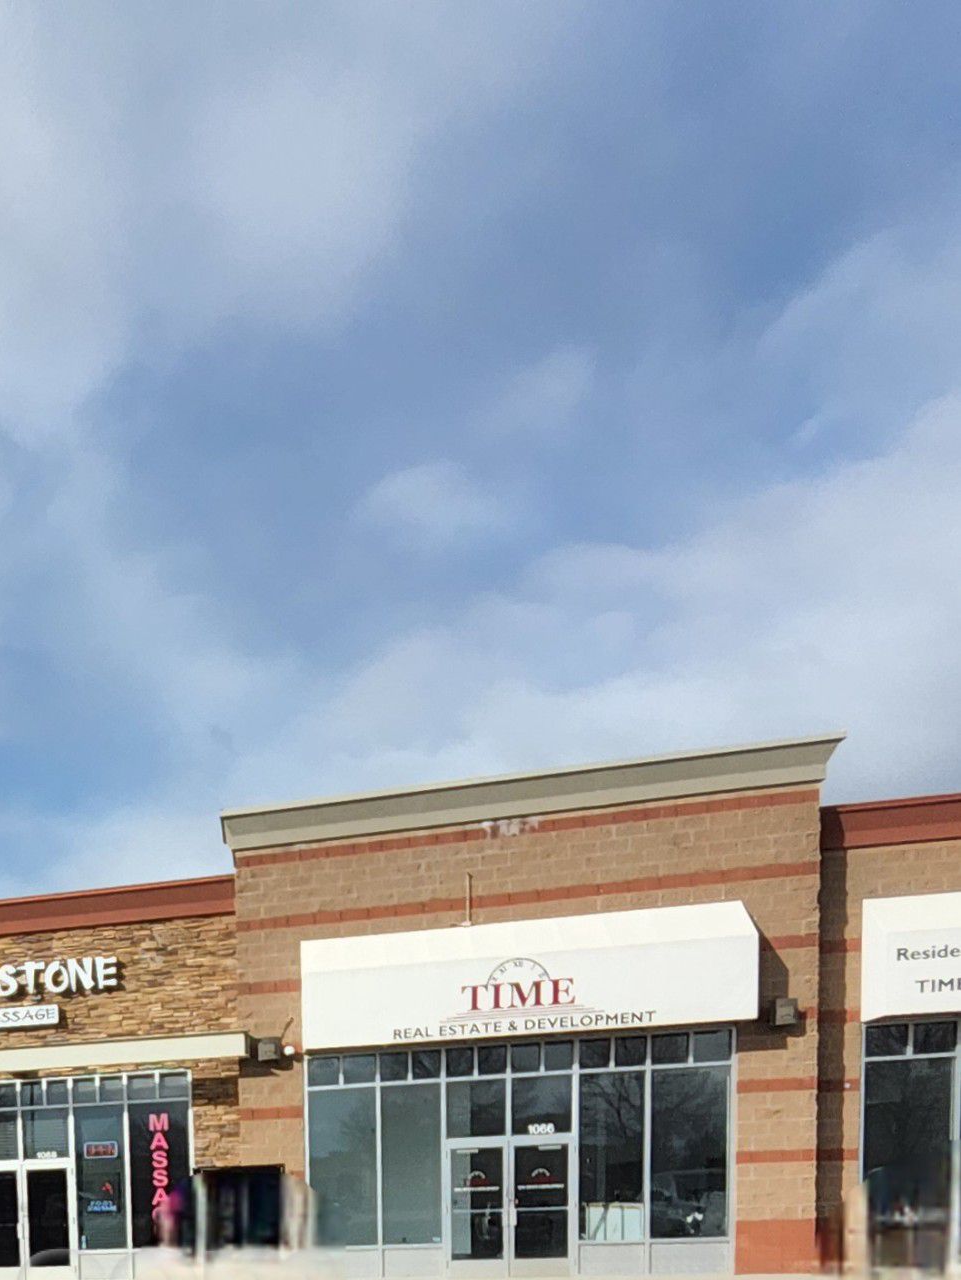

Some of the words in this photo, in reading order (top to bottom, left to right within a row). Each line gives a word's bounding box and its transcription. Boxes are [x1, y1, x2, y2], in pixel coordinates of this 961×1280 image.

[461, 977, 576, 1011] TIME
[393, 1027, 432, 1040] REAL
[439, 1021, 502, 1036] ESTATE
[508, 1020, 518, 1031] &
[524, 1010, 656, 1031] DEVELOPMENT
